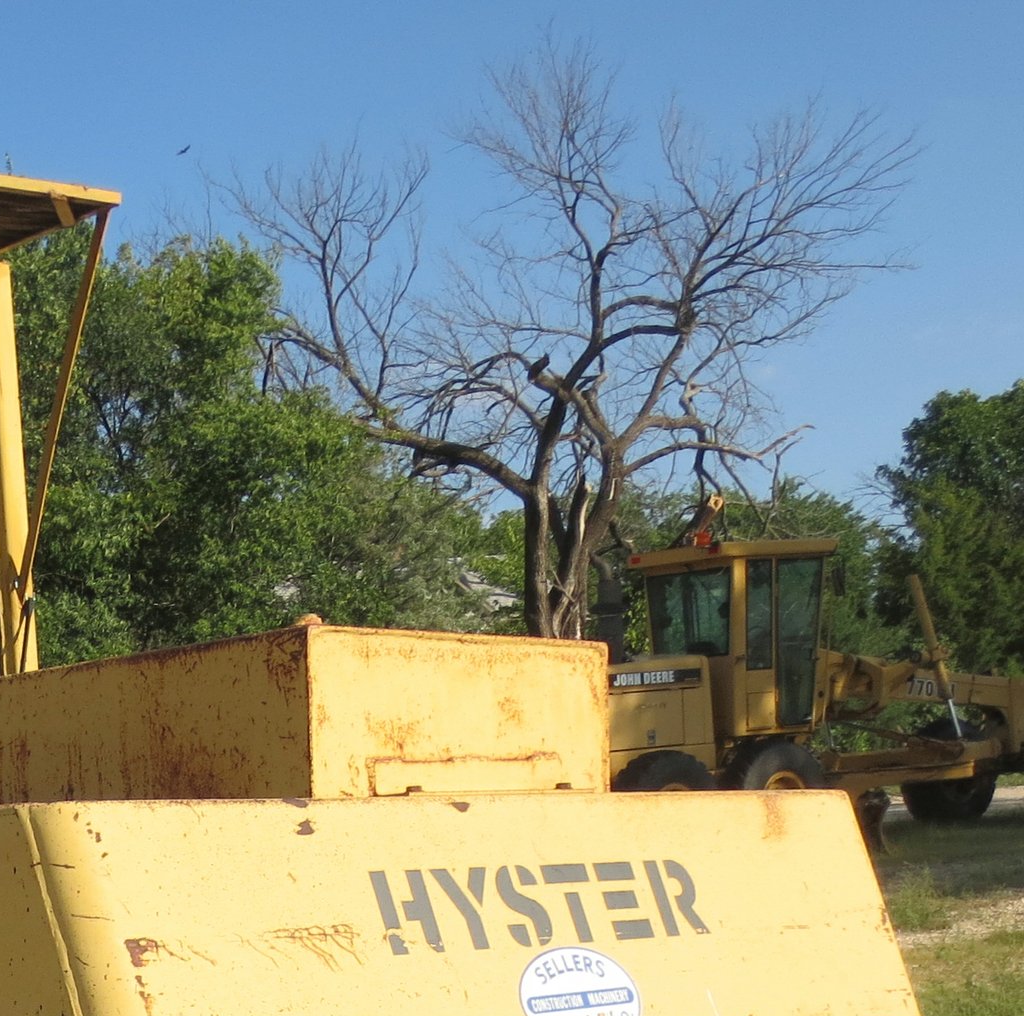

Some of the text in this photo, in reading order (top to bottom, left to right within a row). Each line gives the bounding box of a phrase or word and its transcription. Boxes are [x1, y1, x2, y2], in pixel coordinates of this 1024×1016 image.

[613, 670, 676, 687] JOHN DEERE
[368, 859, 711, 956] HYSTER
[534, 954, 605, 985] SELLERS
